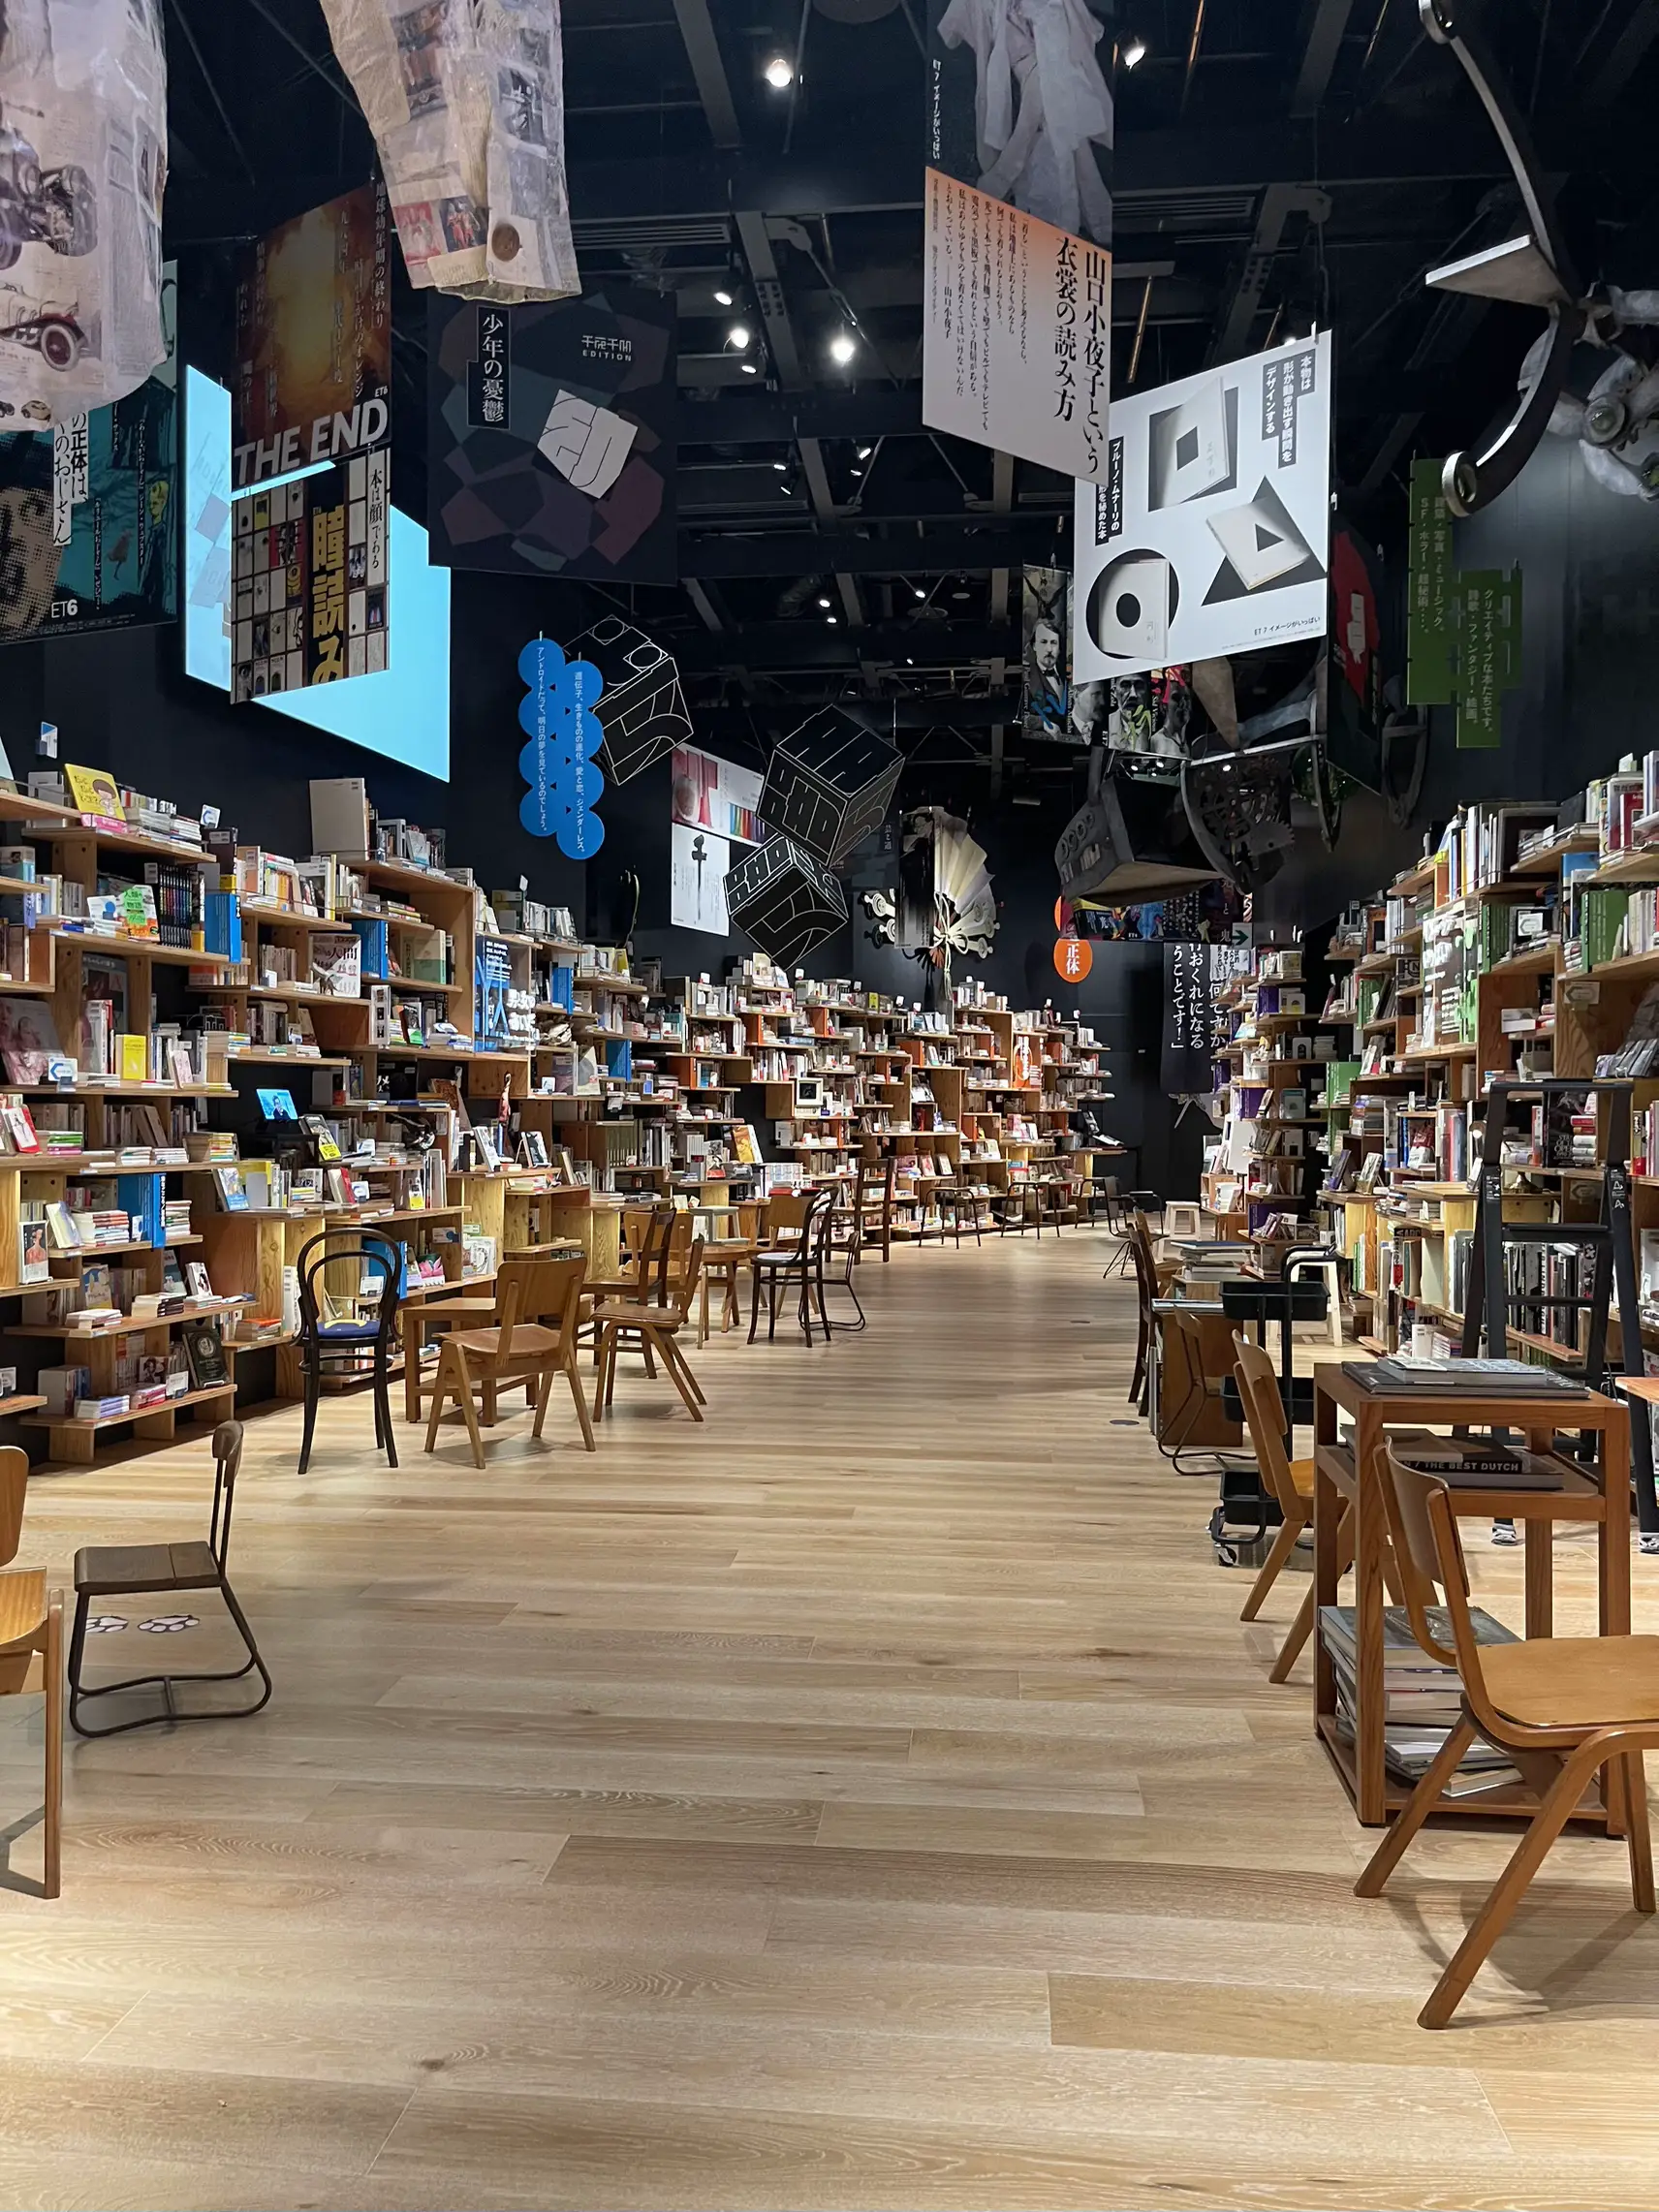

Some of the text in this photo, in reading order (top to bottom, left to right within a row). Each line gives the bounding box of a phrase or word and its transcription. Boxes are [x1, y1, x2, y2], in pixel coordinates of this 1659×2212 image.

[482, 314, 505, 423] 少年の憂鬱
[582, 349, 632, 362] EDITION
[1053, 236, 1079, 422] 衣裳の読み方
[1083, 251, 1107, 474] 山口小夜子という
[1266, 364, 1277, 435] デザインする
[1282, 359, 1295, 463] 形が動き出す瞬間を
[1300, 355, 1313, 392] 本物は
[234, 397, 389, 485] THE END
[368, 468, 384, 570] 本は顔である
[1111, 441, 1122, 532] ブルーノ・ムナーリの
[51, 599, 78, 619] ET6
[1066, 943, 1080, 975] 正体
[1481, 1462, 1519, 1471] DUTCH
